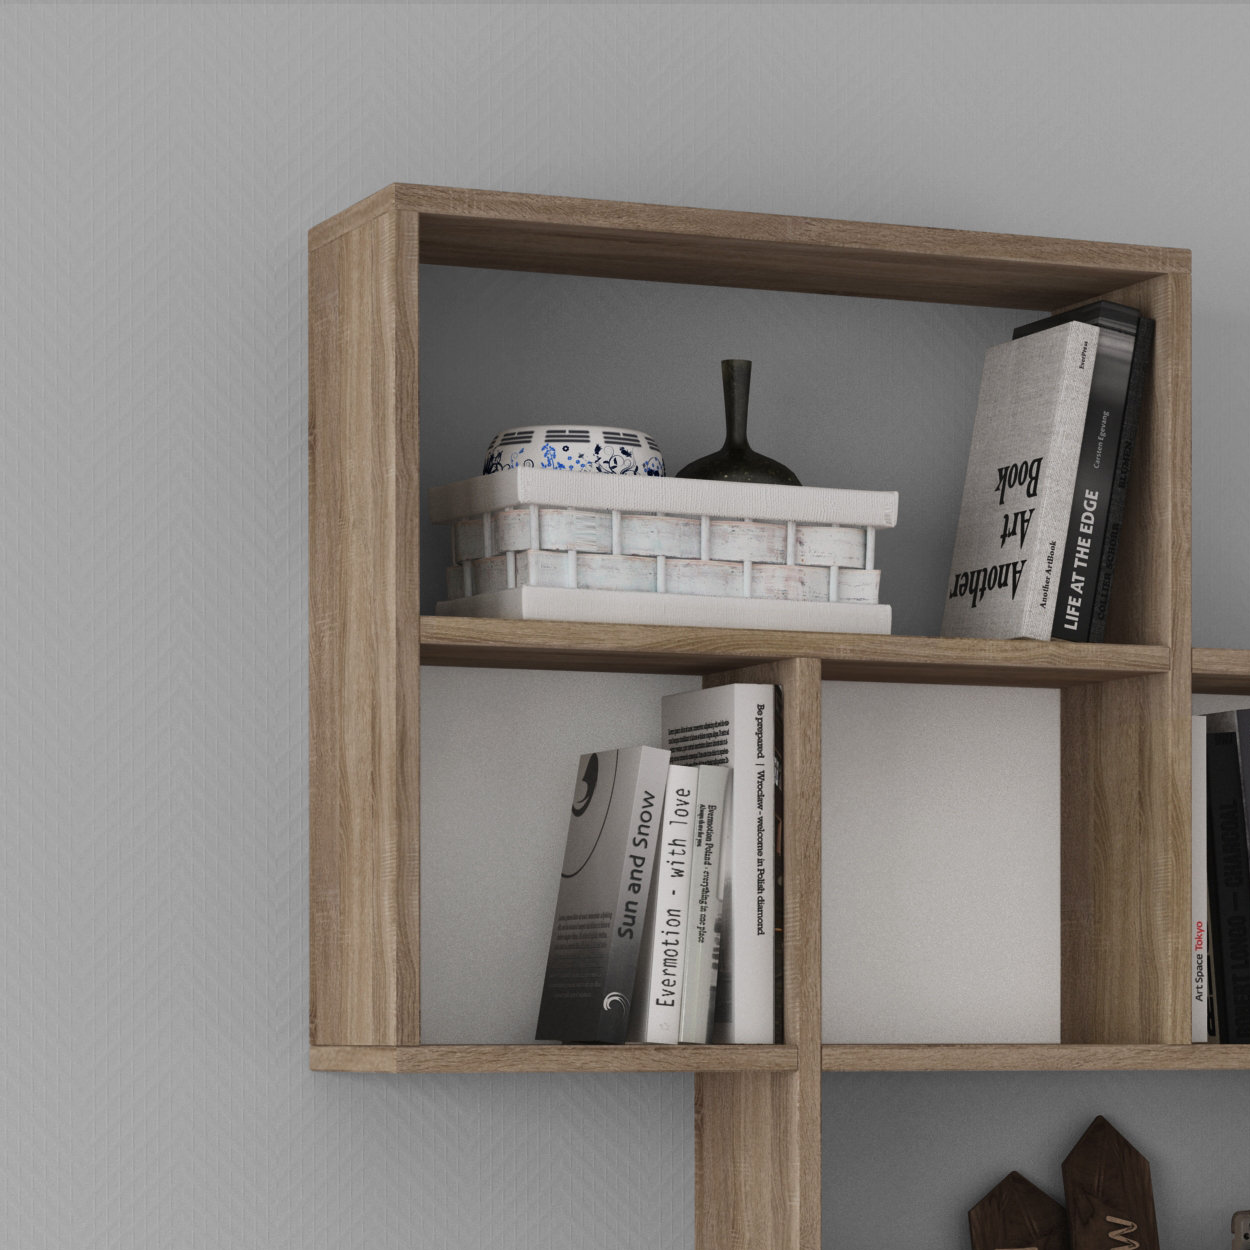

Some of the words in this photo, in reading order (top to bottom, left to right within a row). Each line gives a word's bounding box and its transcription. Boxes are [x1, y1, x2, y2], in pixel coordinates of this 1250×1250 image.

[1093, 440, 1103, 469] Carsten
[1098, 411, 1109, 441] Egevang
[994, 457, 1043, 505] Book
[1001, 508, 1035, 549] Art
[1080, 489, 1099, 535] EDGE
[1074, 537, 1091, 568] THE
[949, 560, 1027, 608] Another
[1040, 575, 1050, 609] Another
[1071, 571, 1085, 595] AT
[1064, 596, 1082, 631] LIFE
[757, 704, 765, 716] Be
[755, 717, 765, 759] prepared
[633, 790, 655, 849] Snow
[669, 788, 690, 825] love
[705, 805, 717, 843] Evermotion
[757, 816, 765, 856] welcome
[628, 855, 646, 894] and
[666, 838, 686, 877] with
[757, 858, 765, 867] in
[757, 868, 765, 894] Polish
[618, 901, 638, 939] Sun
[757, 895, 765, 936] diamond
[1195, 921, 1205, 951] Tokyo
[656, 908, 681, 1007] Evermotion
[1195, 954, 1204, 983] Space
[1195, 985, 1204, 1001] Art
